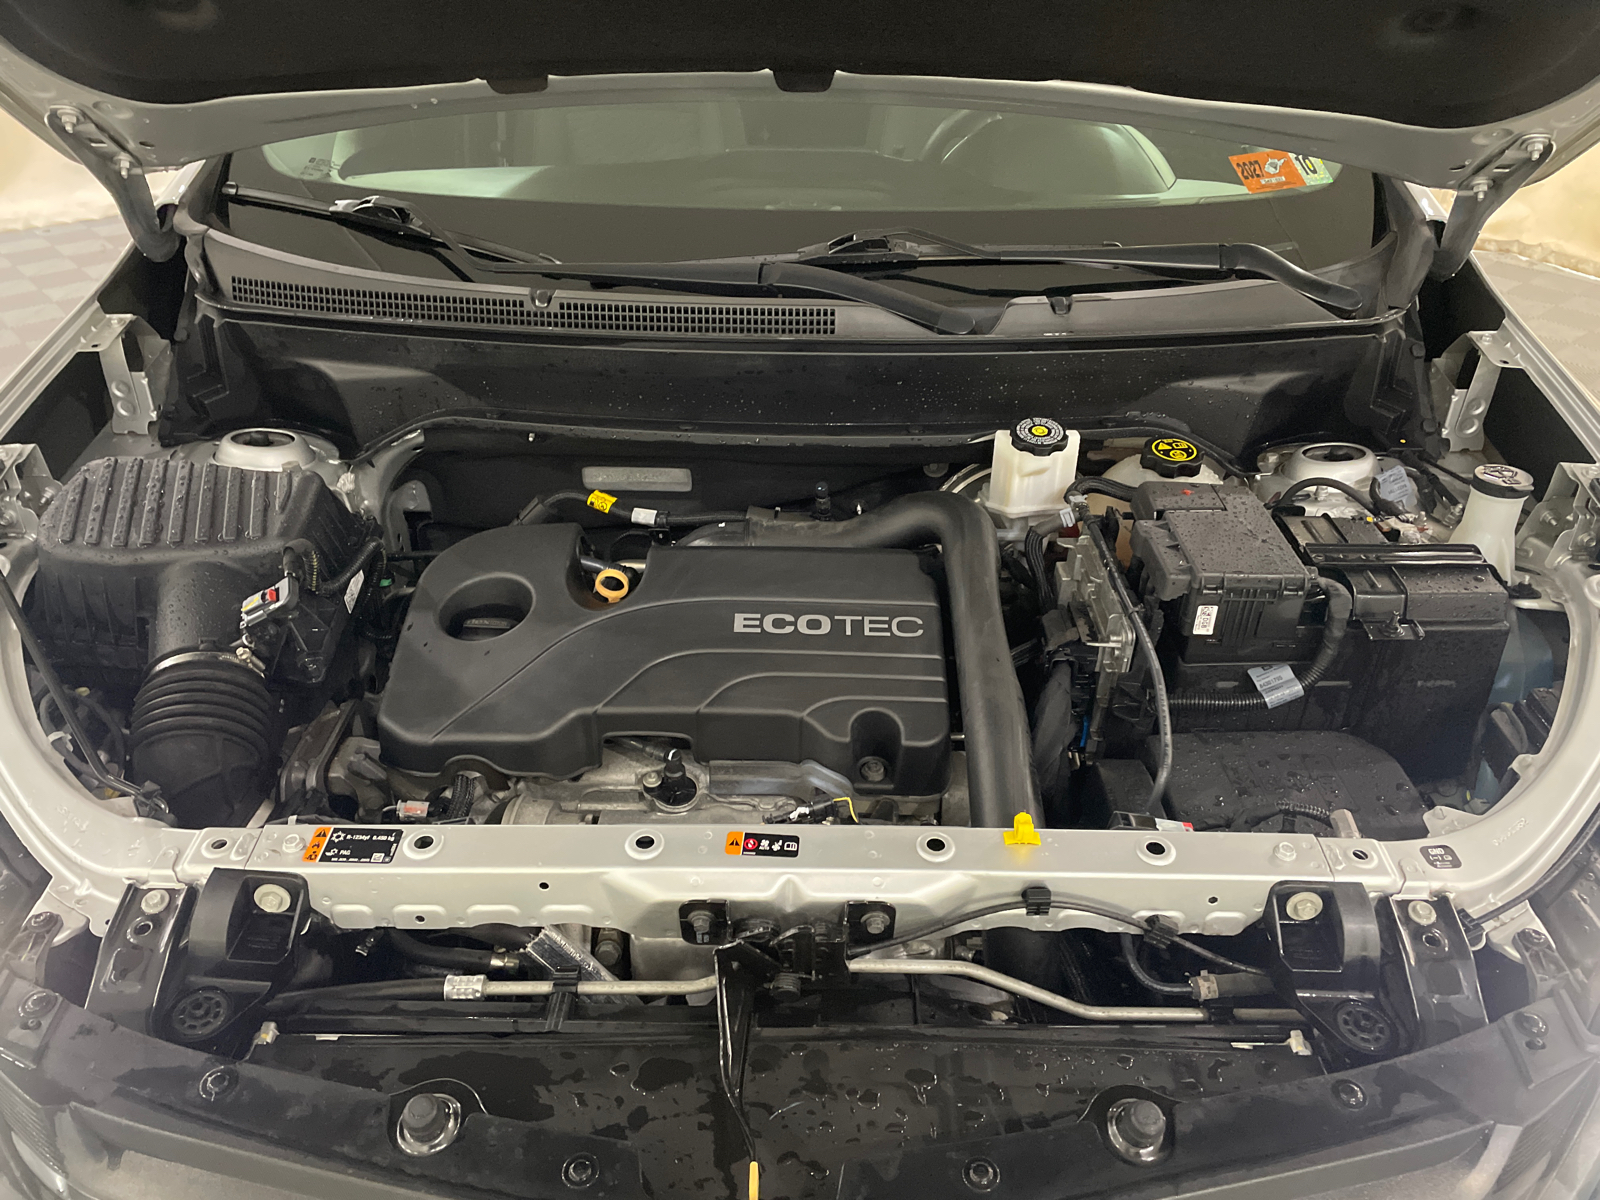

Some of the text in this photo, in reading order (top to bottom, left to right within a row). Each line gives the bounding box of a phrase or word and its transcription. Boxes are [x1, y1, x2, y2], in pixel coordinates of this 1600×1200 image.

[1236, 159, 1265, 180] 2027
[1295, 154, 1318, 176] 10
[733, 612, 924, 638] ECOTEC
